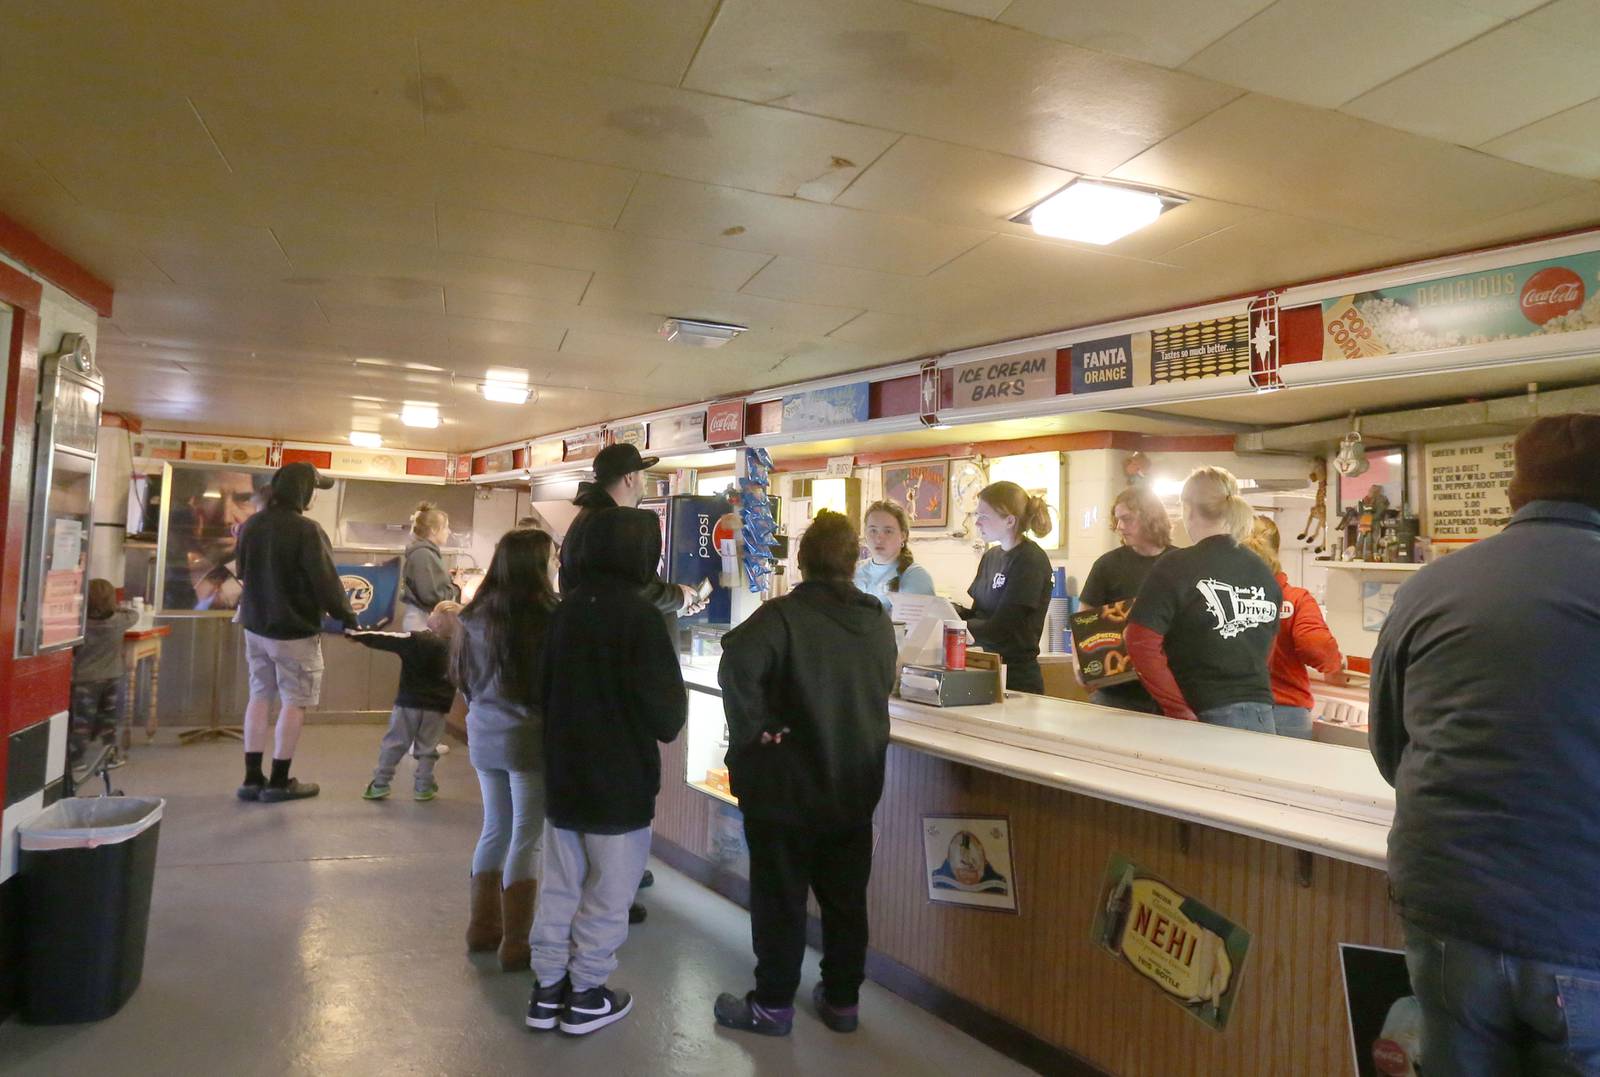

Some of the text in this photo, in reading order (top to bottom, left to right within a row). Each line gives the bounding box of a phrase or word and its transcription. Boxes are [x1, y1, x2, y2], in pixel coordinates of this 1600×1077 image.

[1416, 273, 1516, 308] DELICIOUS
[1341, 308, 1372, 340] POP
[1083, 347, 1127, 369] FANTA
[1160, 343, 1235, 360] Tastes so much better...
[958, 358, 1047, 383] ICE CREAM
[1084, 367, 1127, 384] ORANGE
[971, 379, 1025, 401] BARS
[1460, 446, 1483, 455] RIVER
[1433, 466, 1453, 474] PEPSI
[1462, 464, 1479, 472] DIET
[1465, 491, 1487, 499] CAKE
[1434, 509, 1463, 517] NACHOS
[1434, 517, 1476, 526] JALAPENOS
[698, 514, 710, 558] pepsi
[1434, 526, 1460, 535] PICKLE
[1250, 586, 1266, 600] 34
[1132, 901, 1199, 967] NEHI
[1155, 966, 1182, 990] BOTTLE
